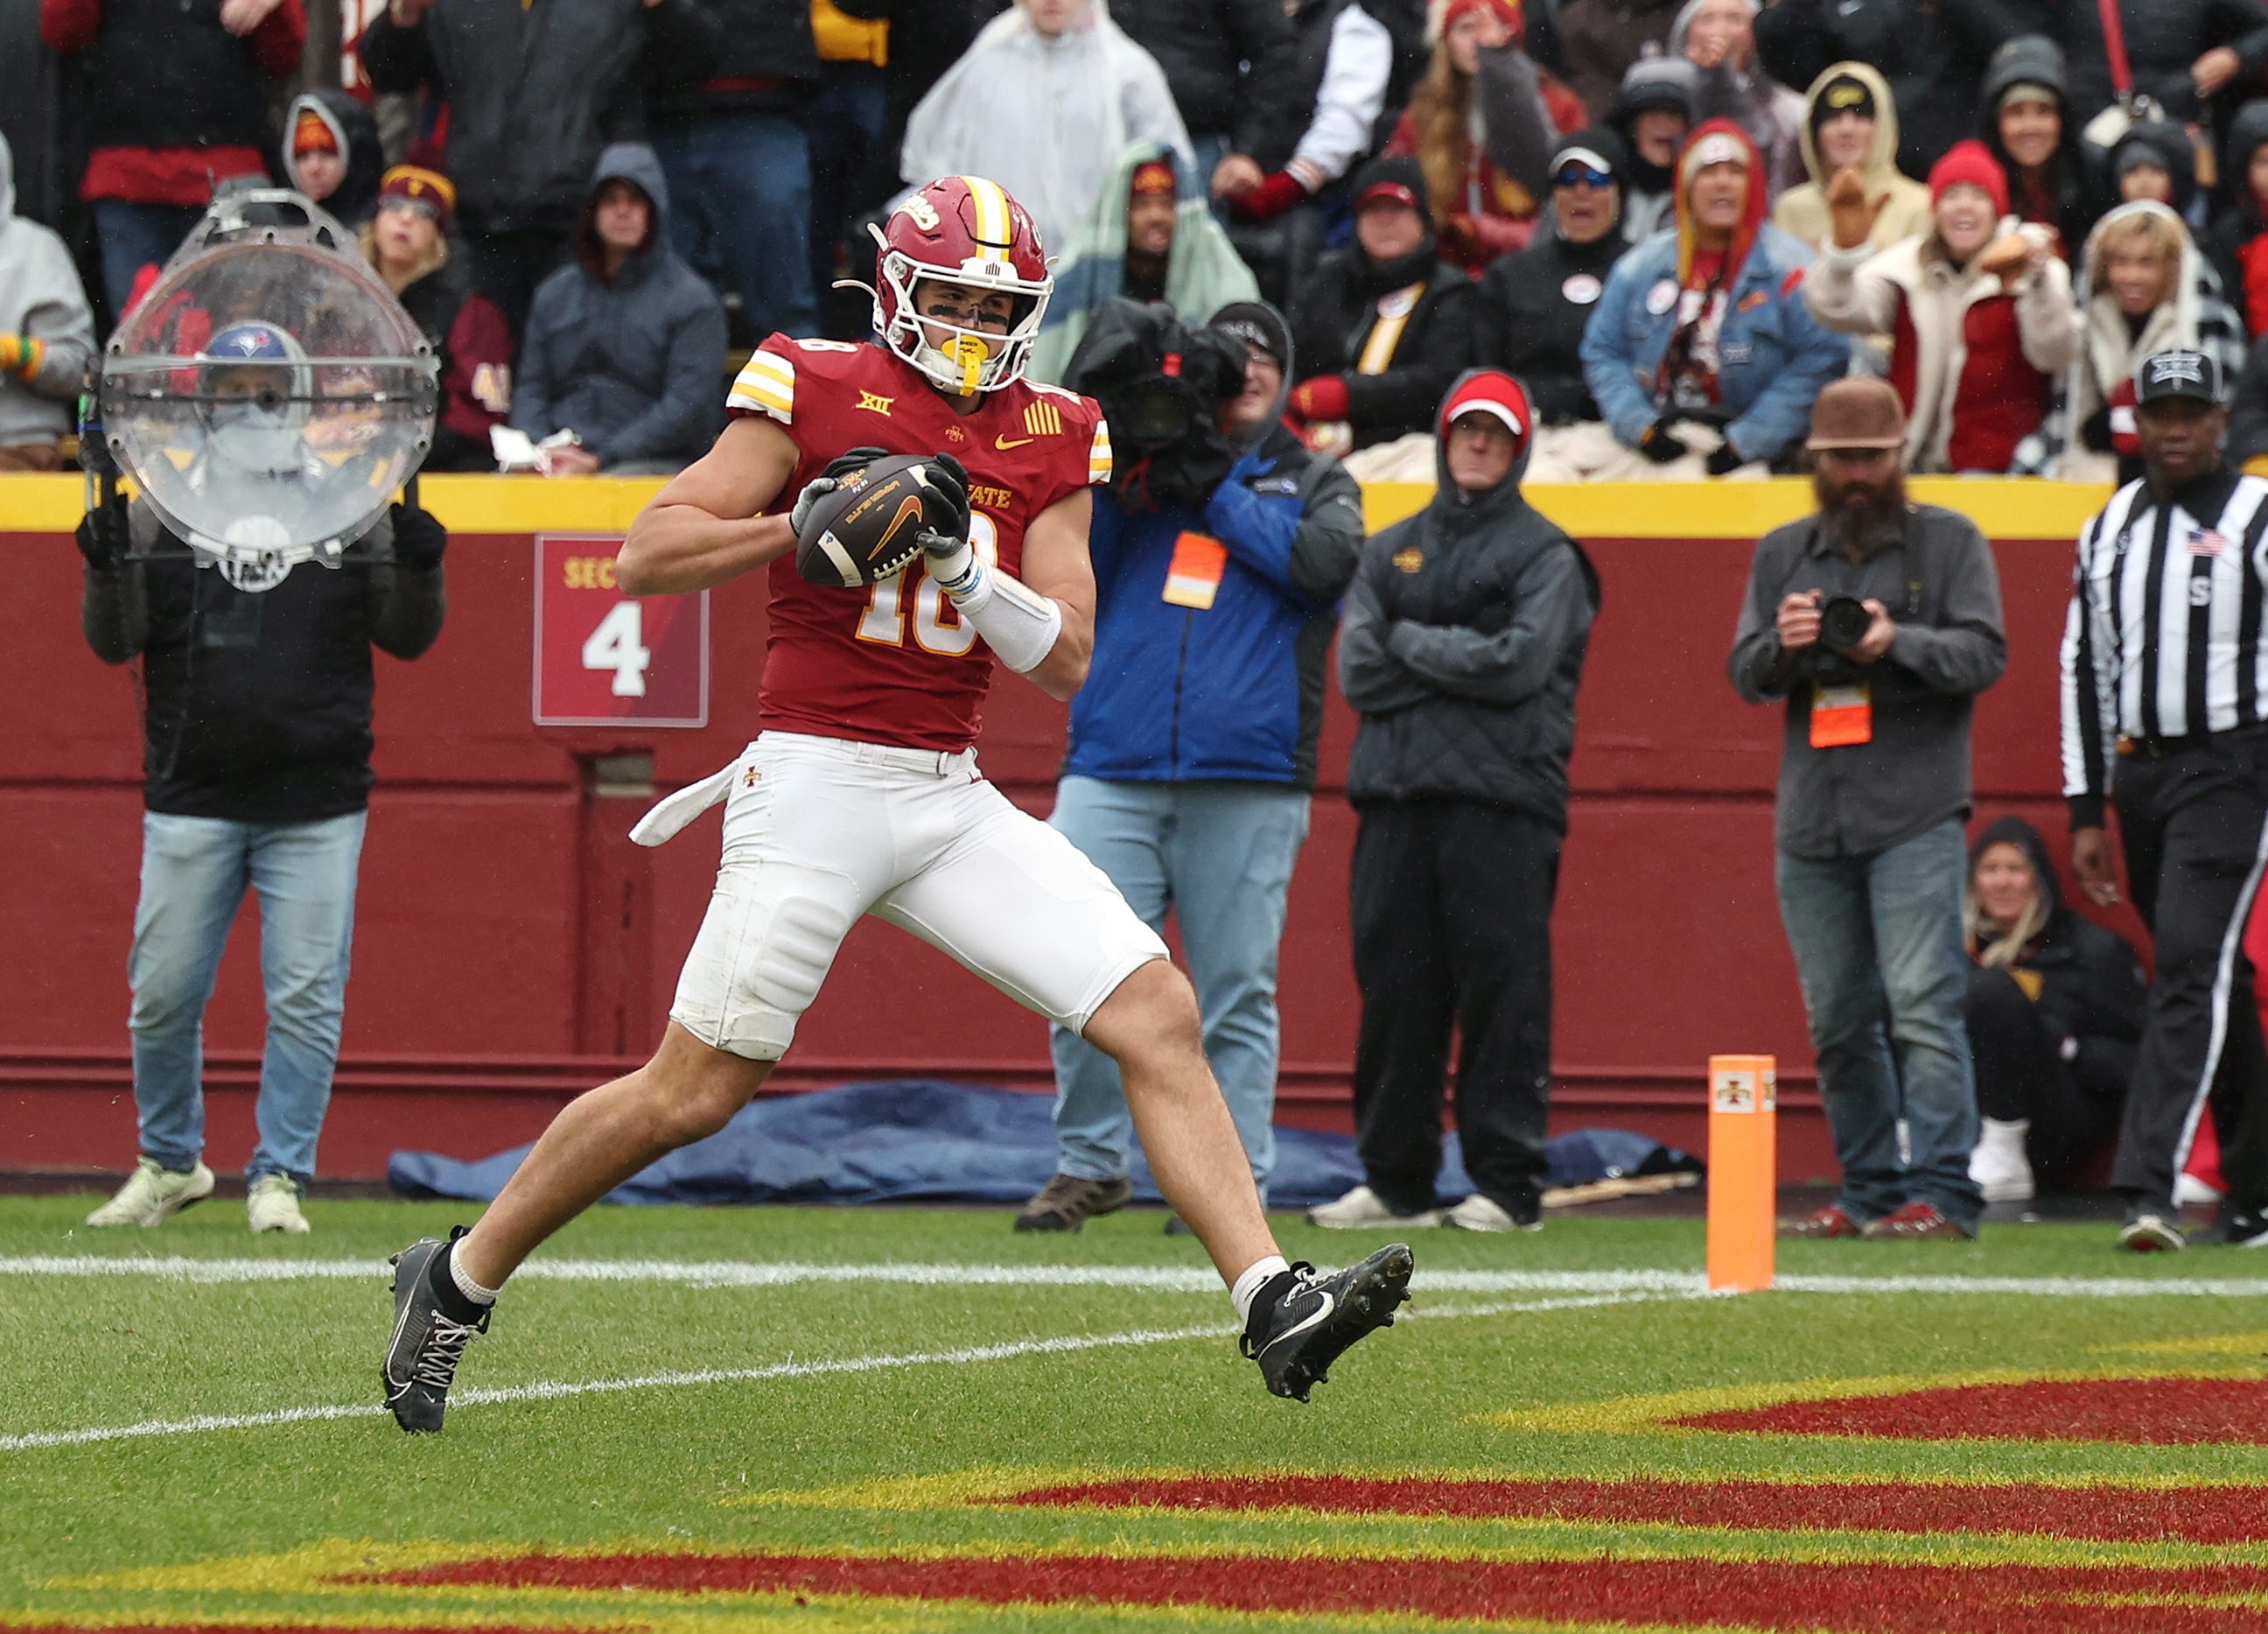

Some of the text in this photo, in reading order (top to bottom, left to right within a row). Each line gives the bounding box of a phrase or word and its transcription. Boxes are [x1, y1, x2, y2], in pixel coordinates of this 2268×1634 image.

[855, 389, 895, 417] XII
[968, 484, 1012, 509] ATE
[2189, 575, 2212, 607] S
[581, 600, 651, 698] 4
